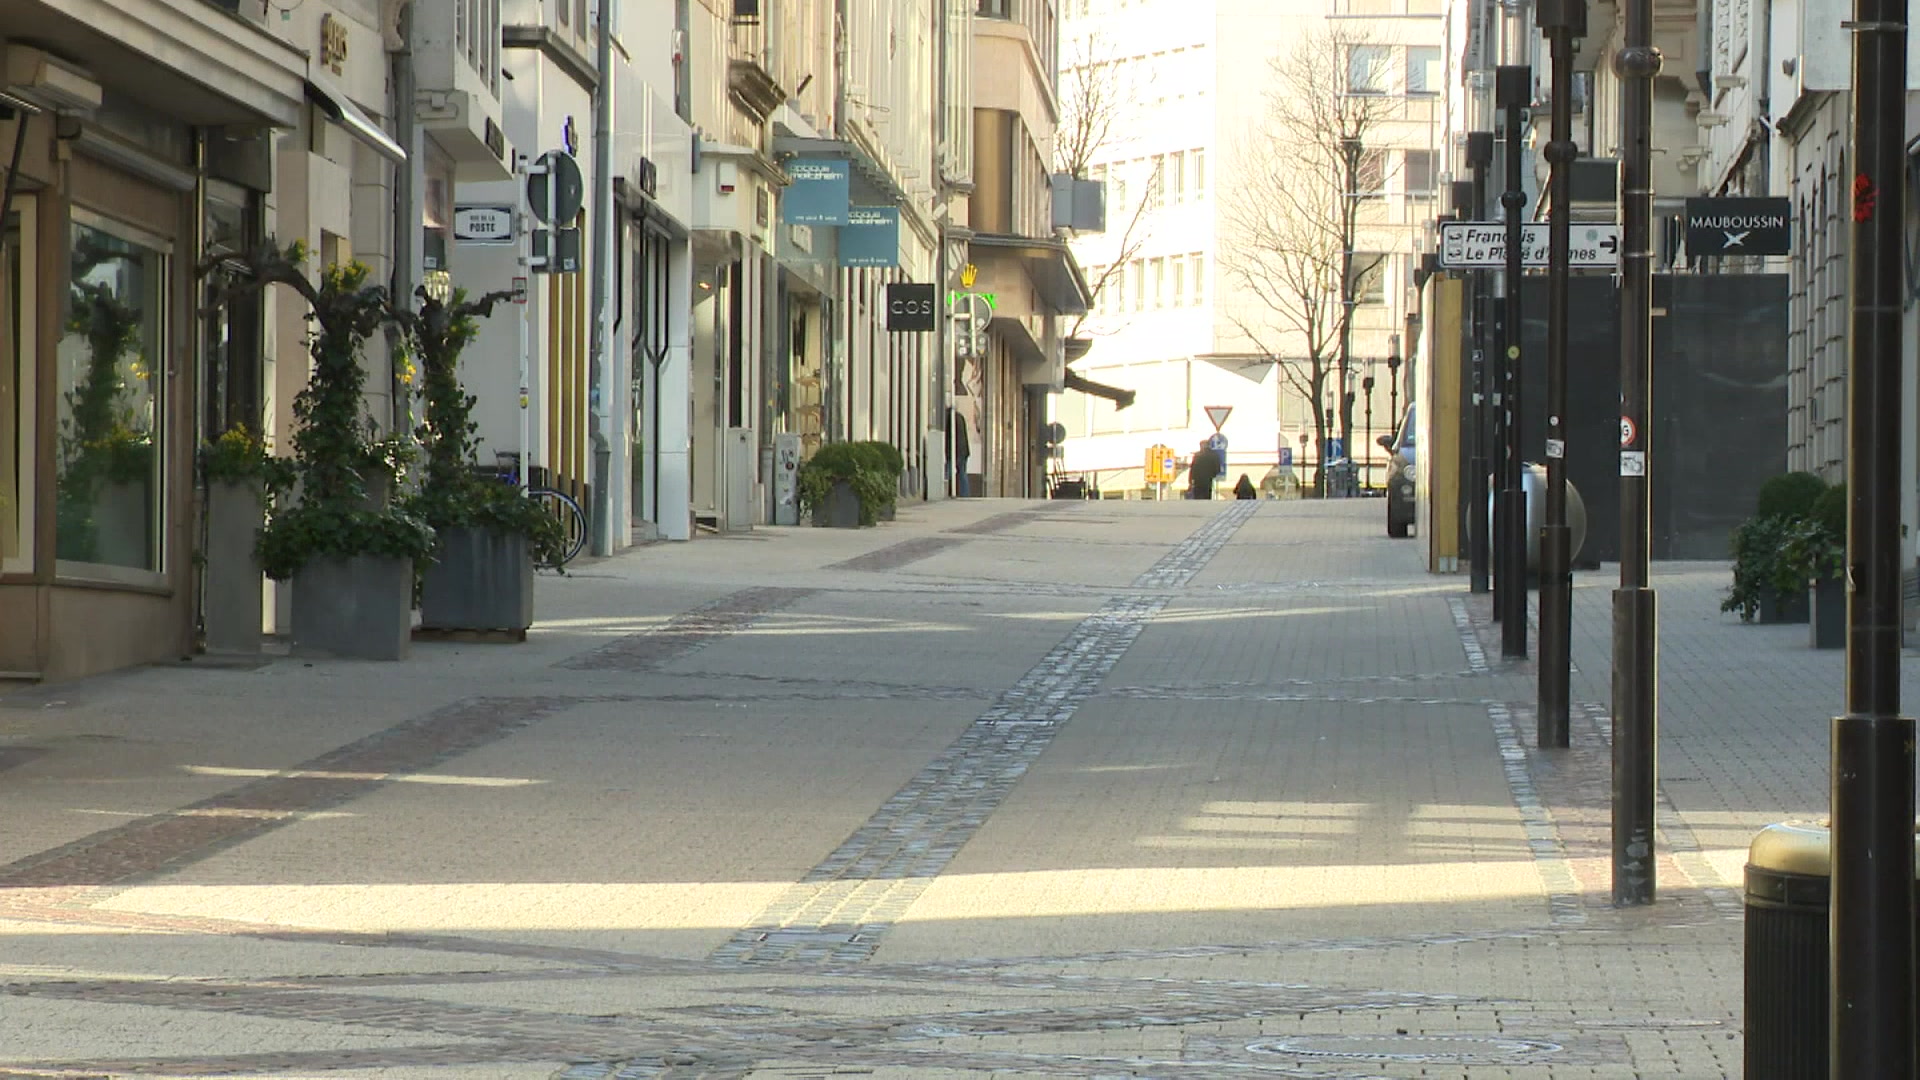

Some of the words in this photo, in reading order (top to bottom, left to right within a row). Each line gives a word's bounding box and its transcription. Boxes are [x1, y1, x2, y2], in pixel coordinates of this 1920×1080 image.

[470, 223, 496, 233] POSTE
[1690, 215, 1784, 229] MAUBOUSSIN
[1466, 247, 1484, 260] Le
[891, 300, 931, 315] COS
